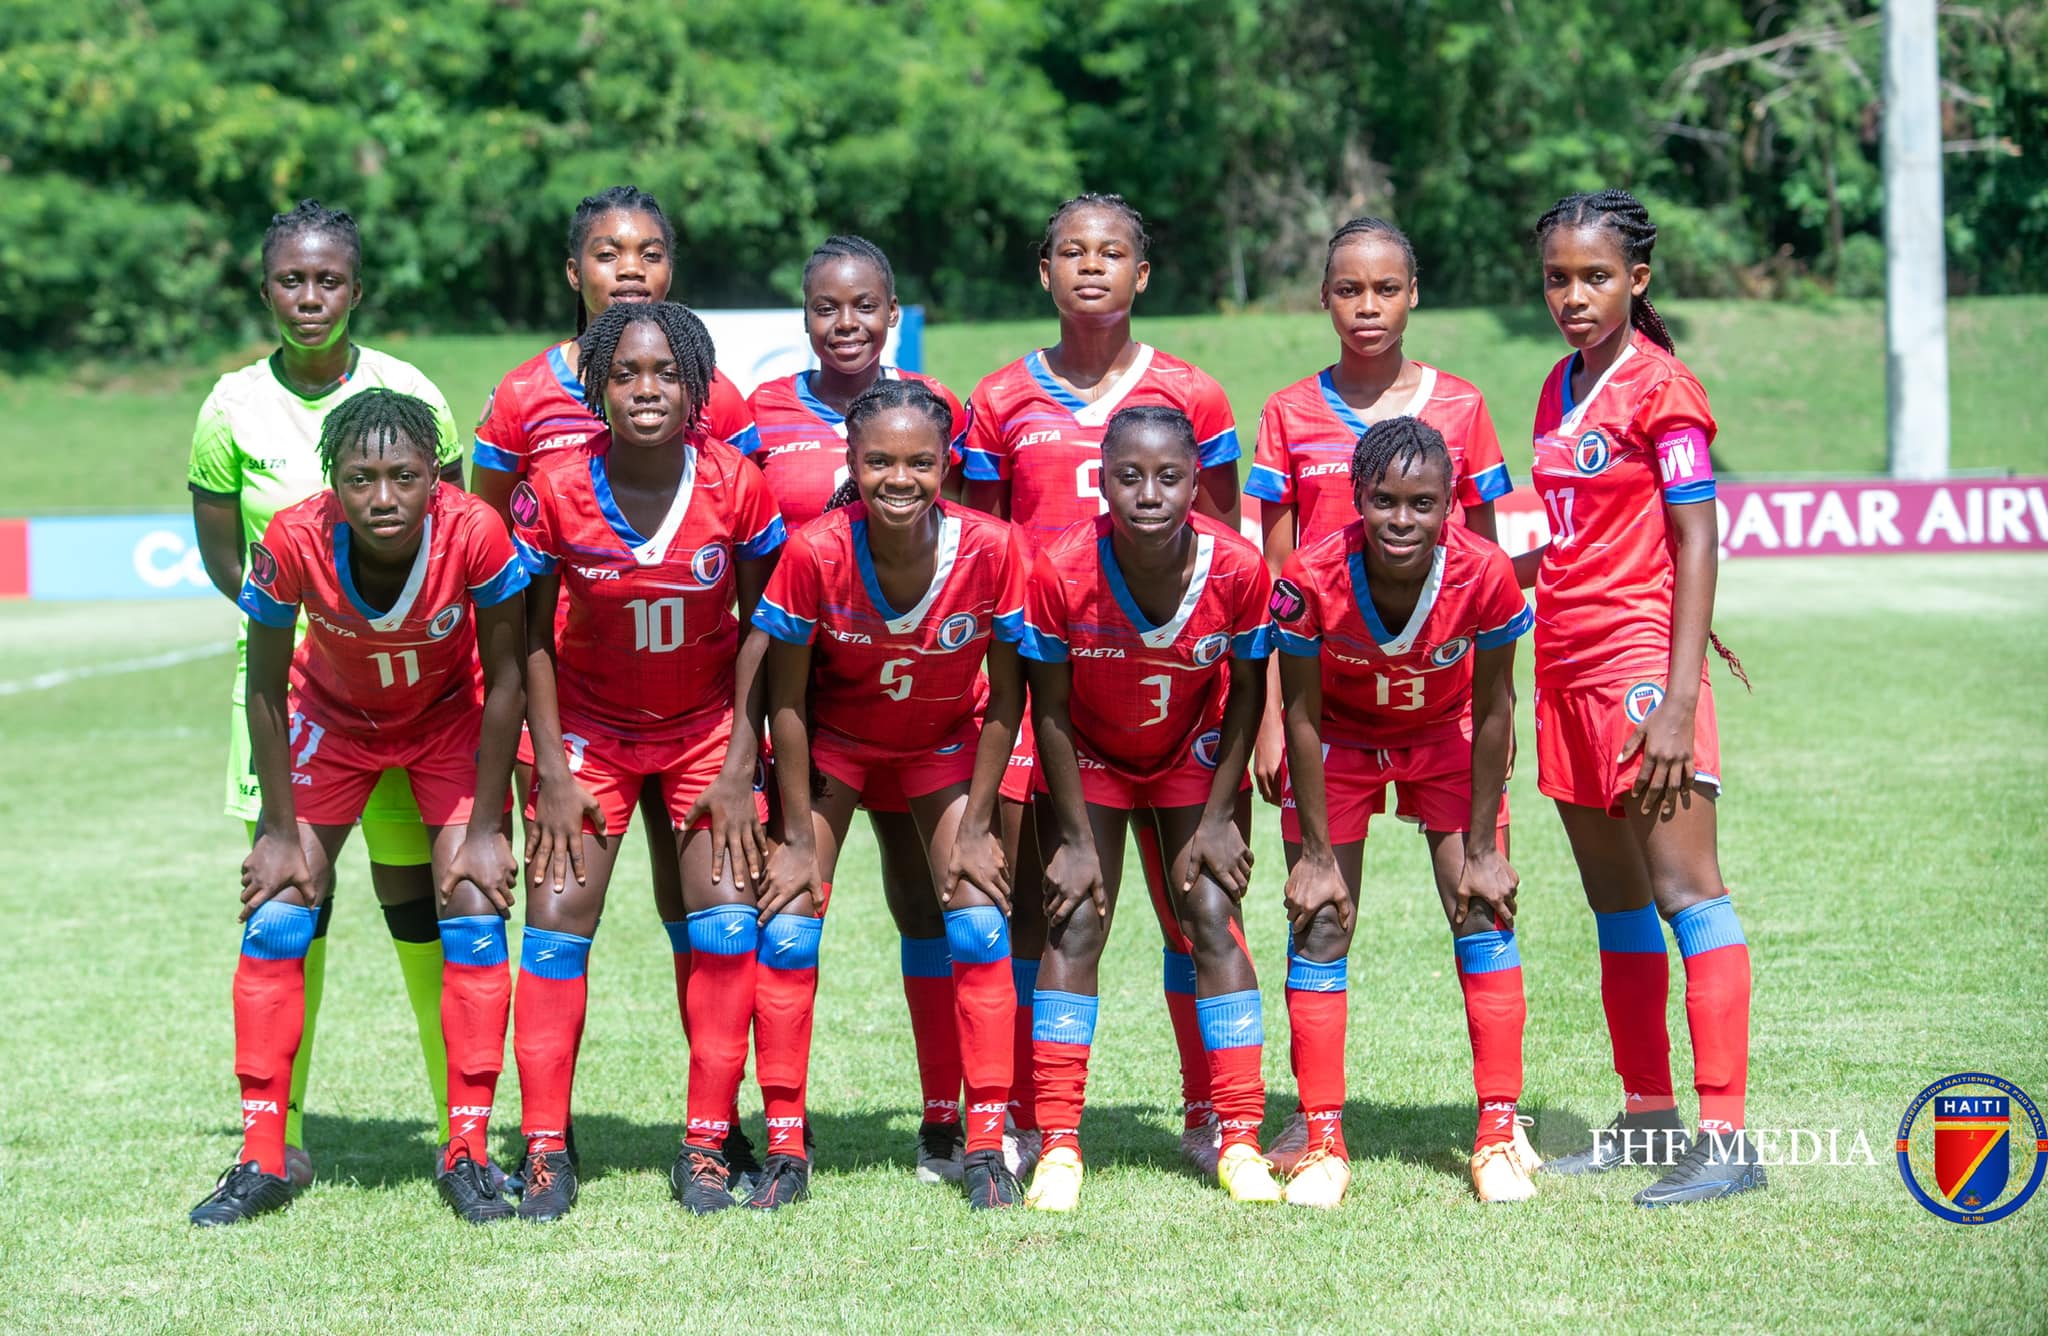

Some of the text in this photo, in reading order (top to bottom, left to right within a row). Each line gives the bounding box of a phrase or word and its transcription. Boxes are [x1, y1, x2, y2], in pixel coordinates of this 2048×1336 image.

[768, 440, 821, 457] SAETA
[1300, 462, 1350, 478] SAETA
[622, 597, 685, 653] 10
[1071, 647, 1126, 659] SAETA
[366, 650, 420, 688] 11
[879, 658, 915, 702] 5
[1138, 674, 1172, 728] 3
[1374, 671, 1425, 711] 13
[1008, 755, 1034, 767] ETA
[243, 1100, 278, 1114] AETA
